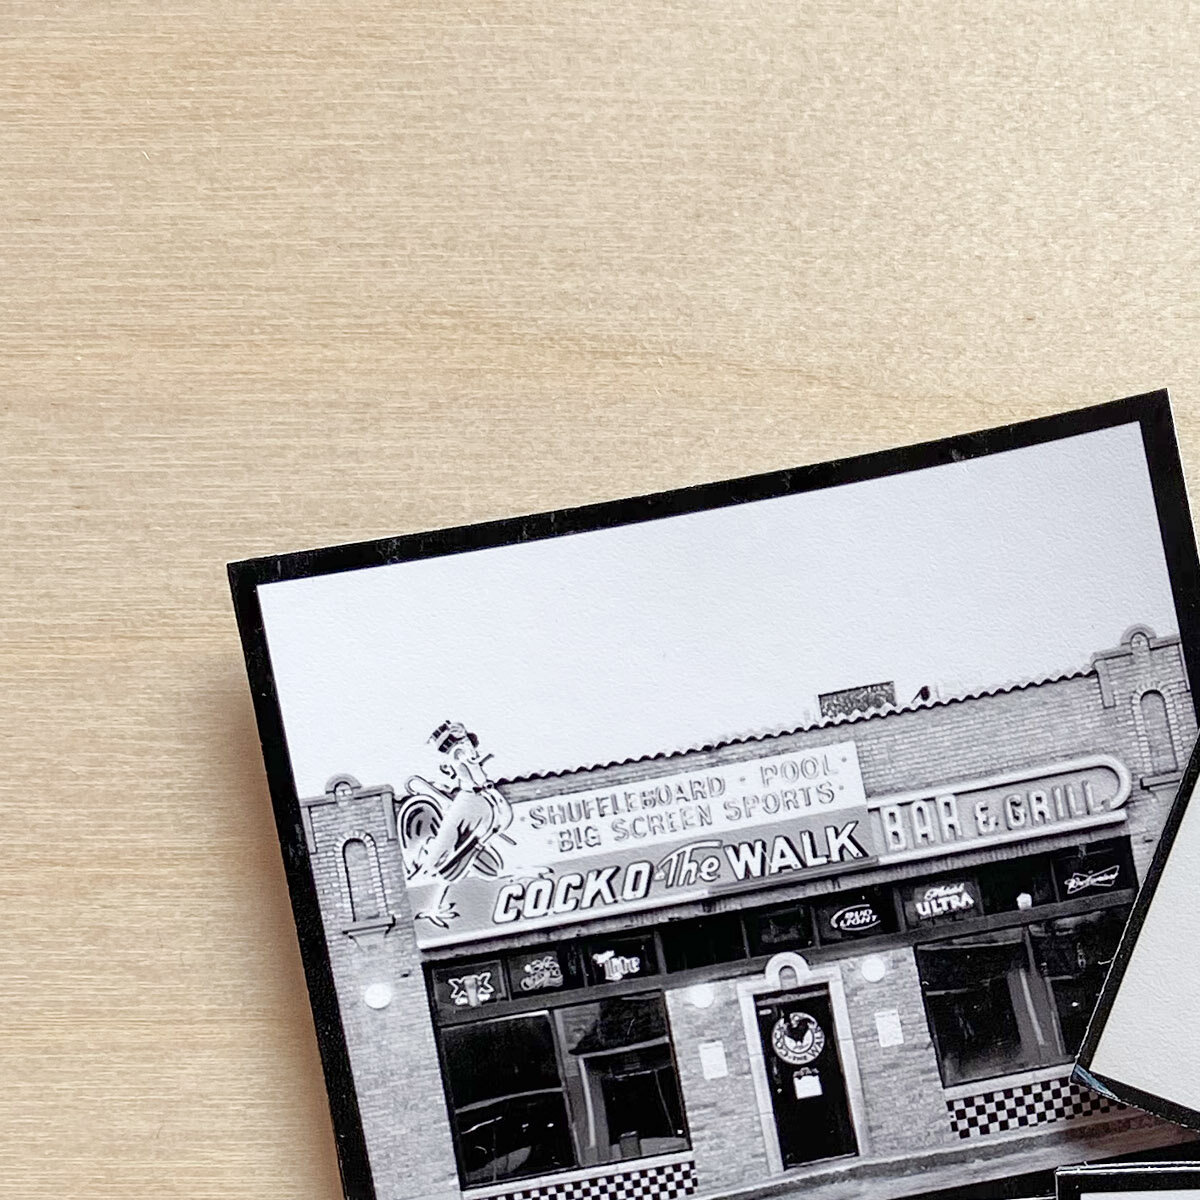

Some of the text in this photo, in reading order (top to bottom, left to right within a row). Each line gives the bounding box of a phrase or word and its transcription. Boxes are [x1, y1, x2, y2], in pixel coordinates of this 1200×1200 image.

[528, 753, 840, 830] SHUFFLEBOARD POOL
[559, 784, 836, 854] BIG SCREEN SPORTS
[880, 780, 1105, 851] BAR & GRILL
[654, 840, 722, 889] The
[725, 820, 869, 881] WALK
[915, 892, 975, 920] ULTRA
